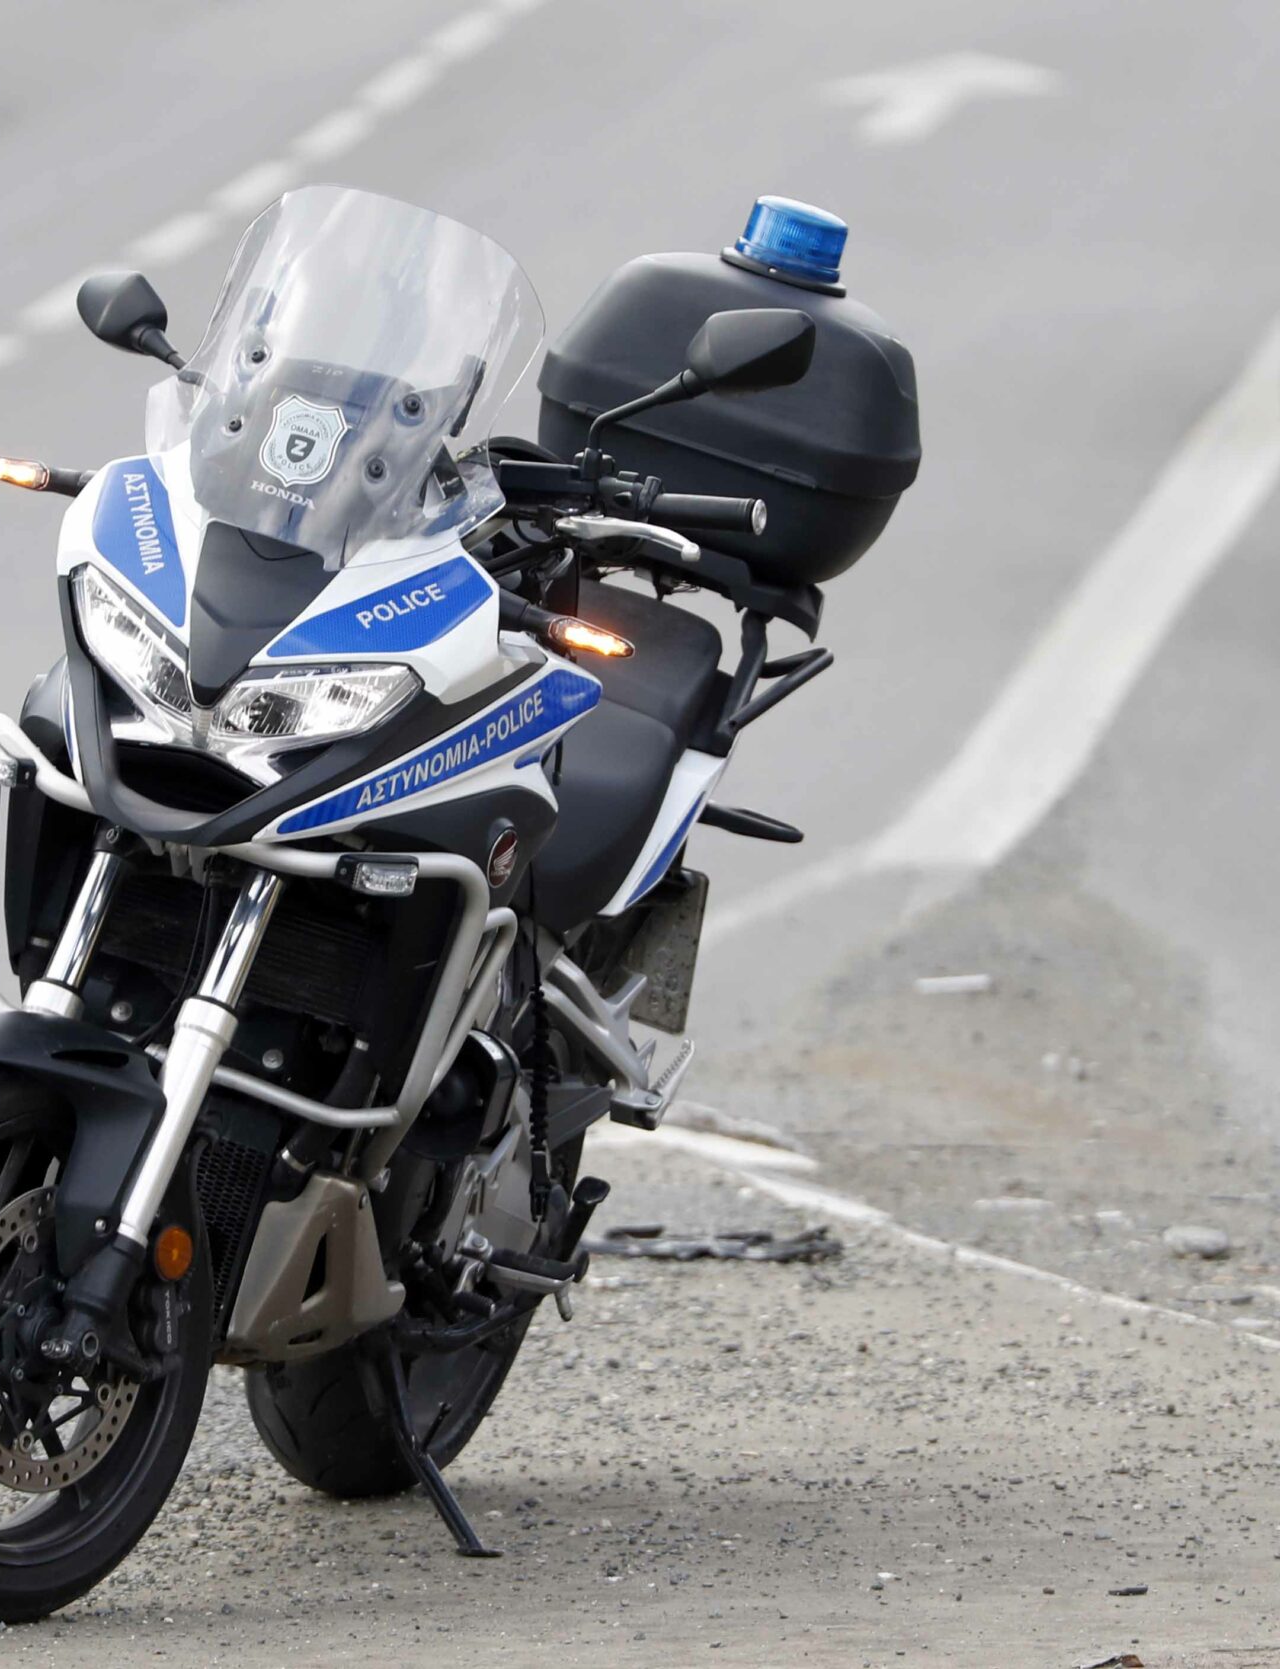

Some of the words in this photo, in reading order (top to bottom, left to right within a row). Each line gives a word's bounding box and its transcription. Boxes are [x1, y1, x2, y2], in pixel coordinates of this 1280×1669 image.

[277, 454, 311, 471] POLICE
[250, 480, 316, 510] HONDA
[123, 473, 165, 575] ΑΣΤΥΝΟΜΙΑ
[356, 583, 446, 630] POLICE
[355, 689, 545, 810] ΑΣΤΥΝΟΜΙΑ-POLICE
